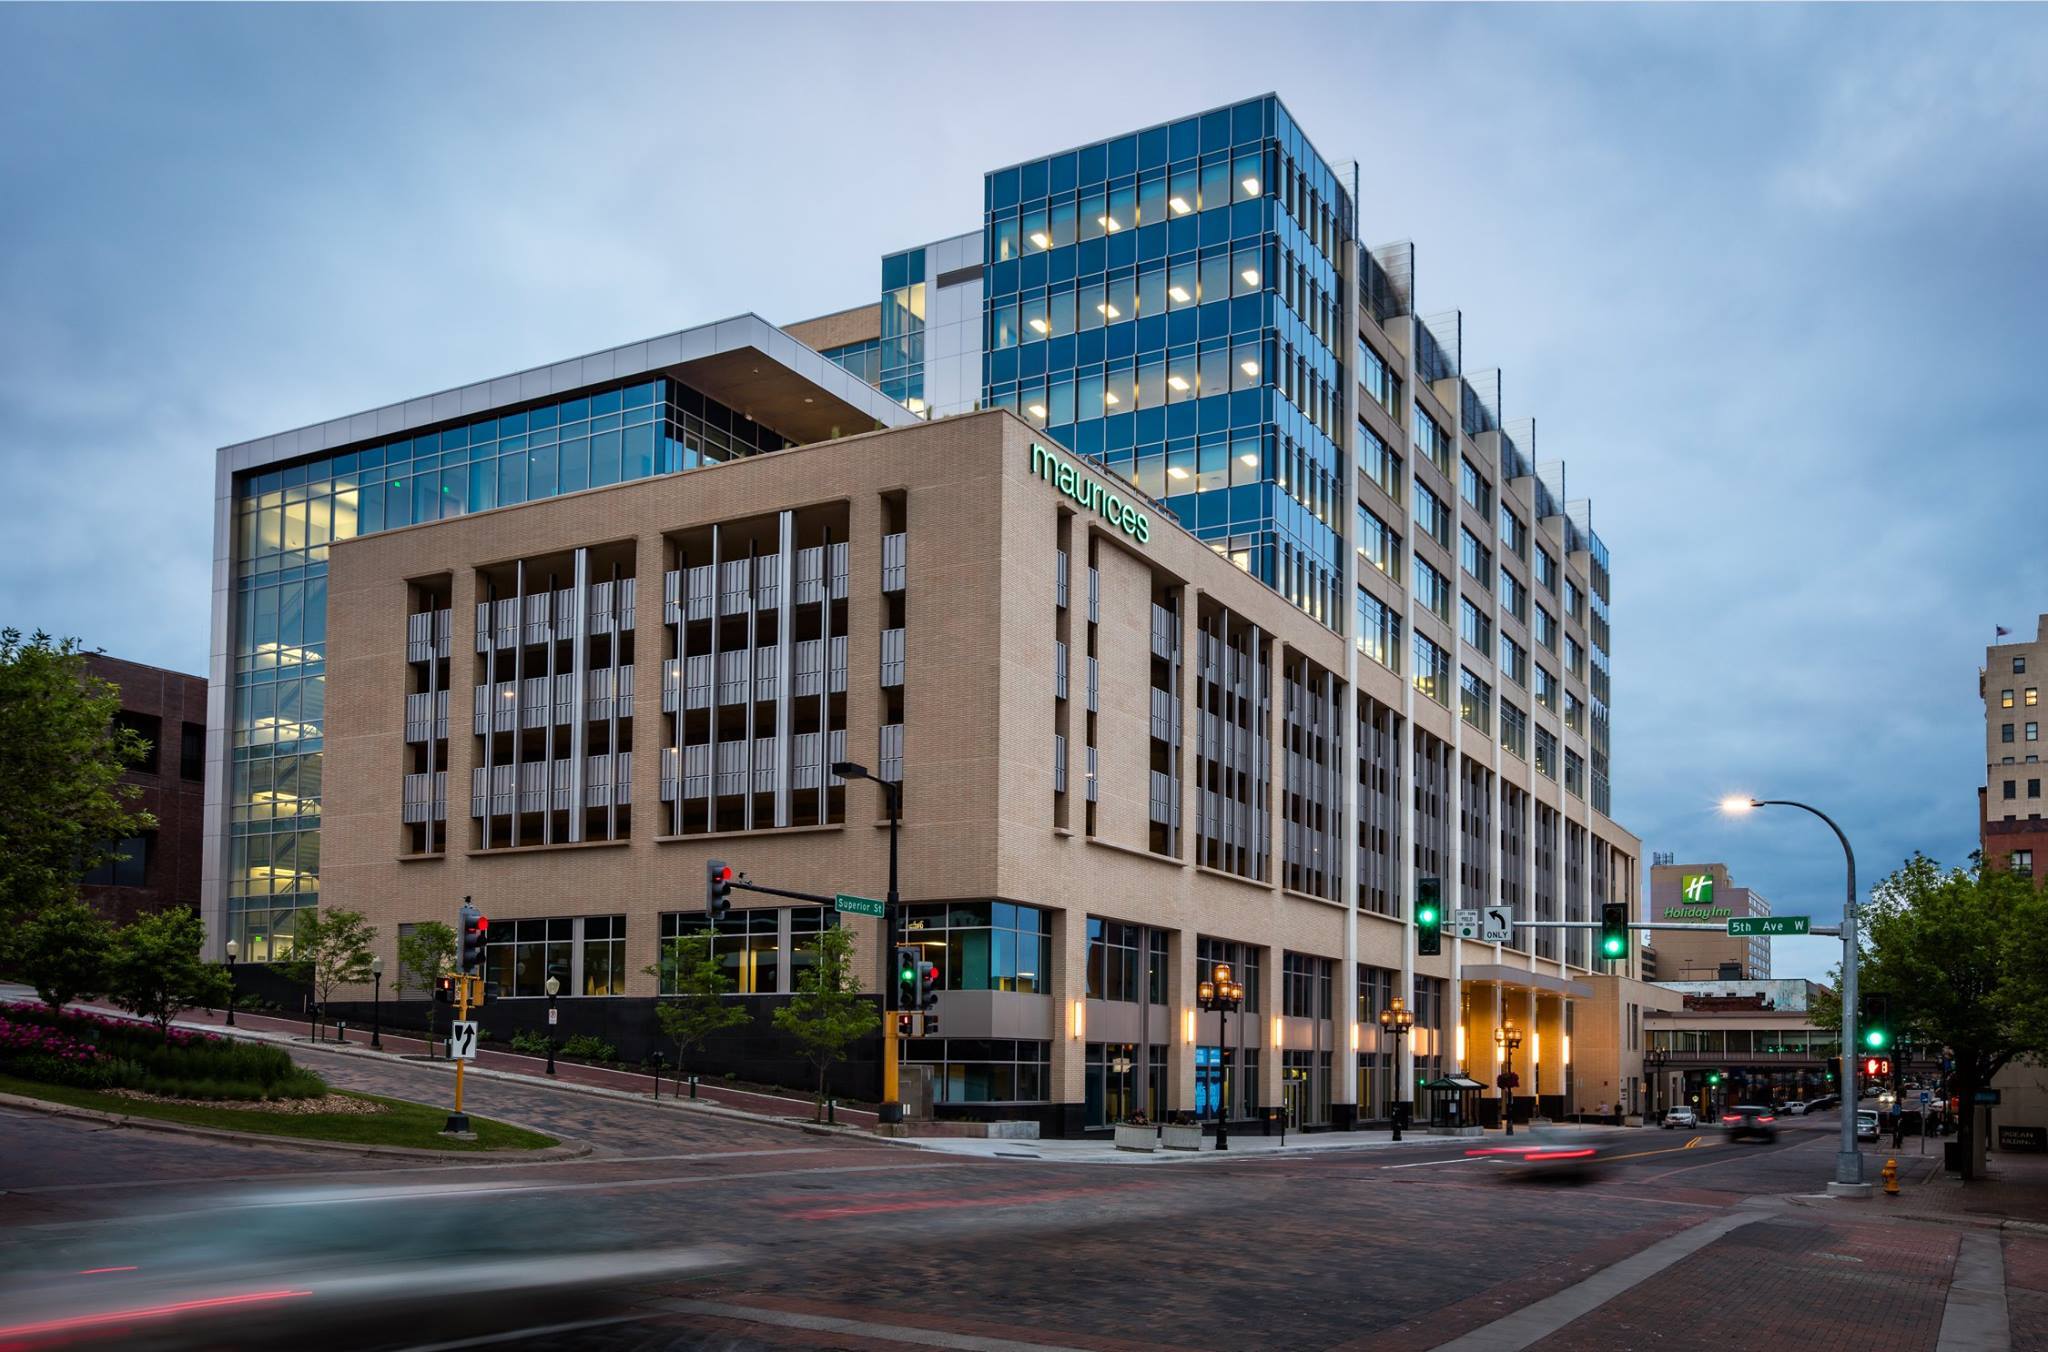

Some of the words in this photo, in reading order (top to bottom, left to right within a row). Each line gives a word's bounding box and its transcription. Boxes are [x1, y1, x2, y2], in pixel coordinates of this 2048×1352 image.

[1031, 443, 1149, 544] maurices
[838, 898, 870, 911] Superior
[874, 904, 882, 913] St
[1664, 906, 1711, 920] Holiday
[1712, 906, 1732, 916] Inn
[1732, 922, 1752, 932] 5th
[1762, 921, 1783, 931] Ave
[1794, 920, 1804, 930] W
[1487, 931, 1508, 939] ONLY
